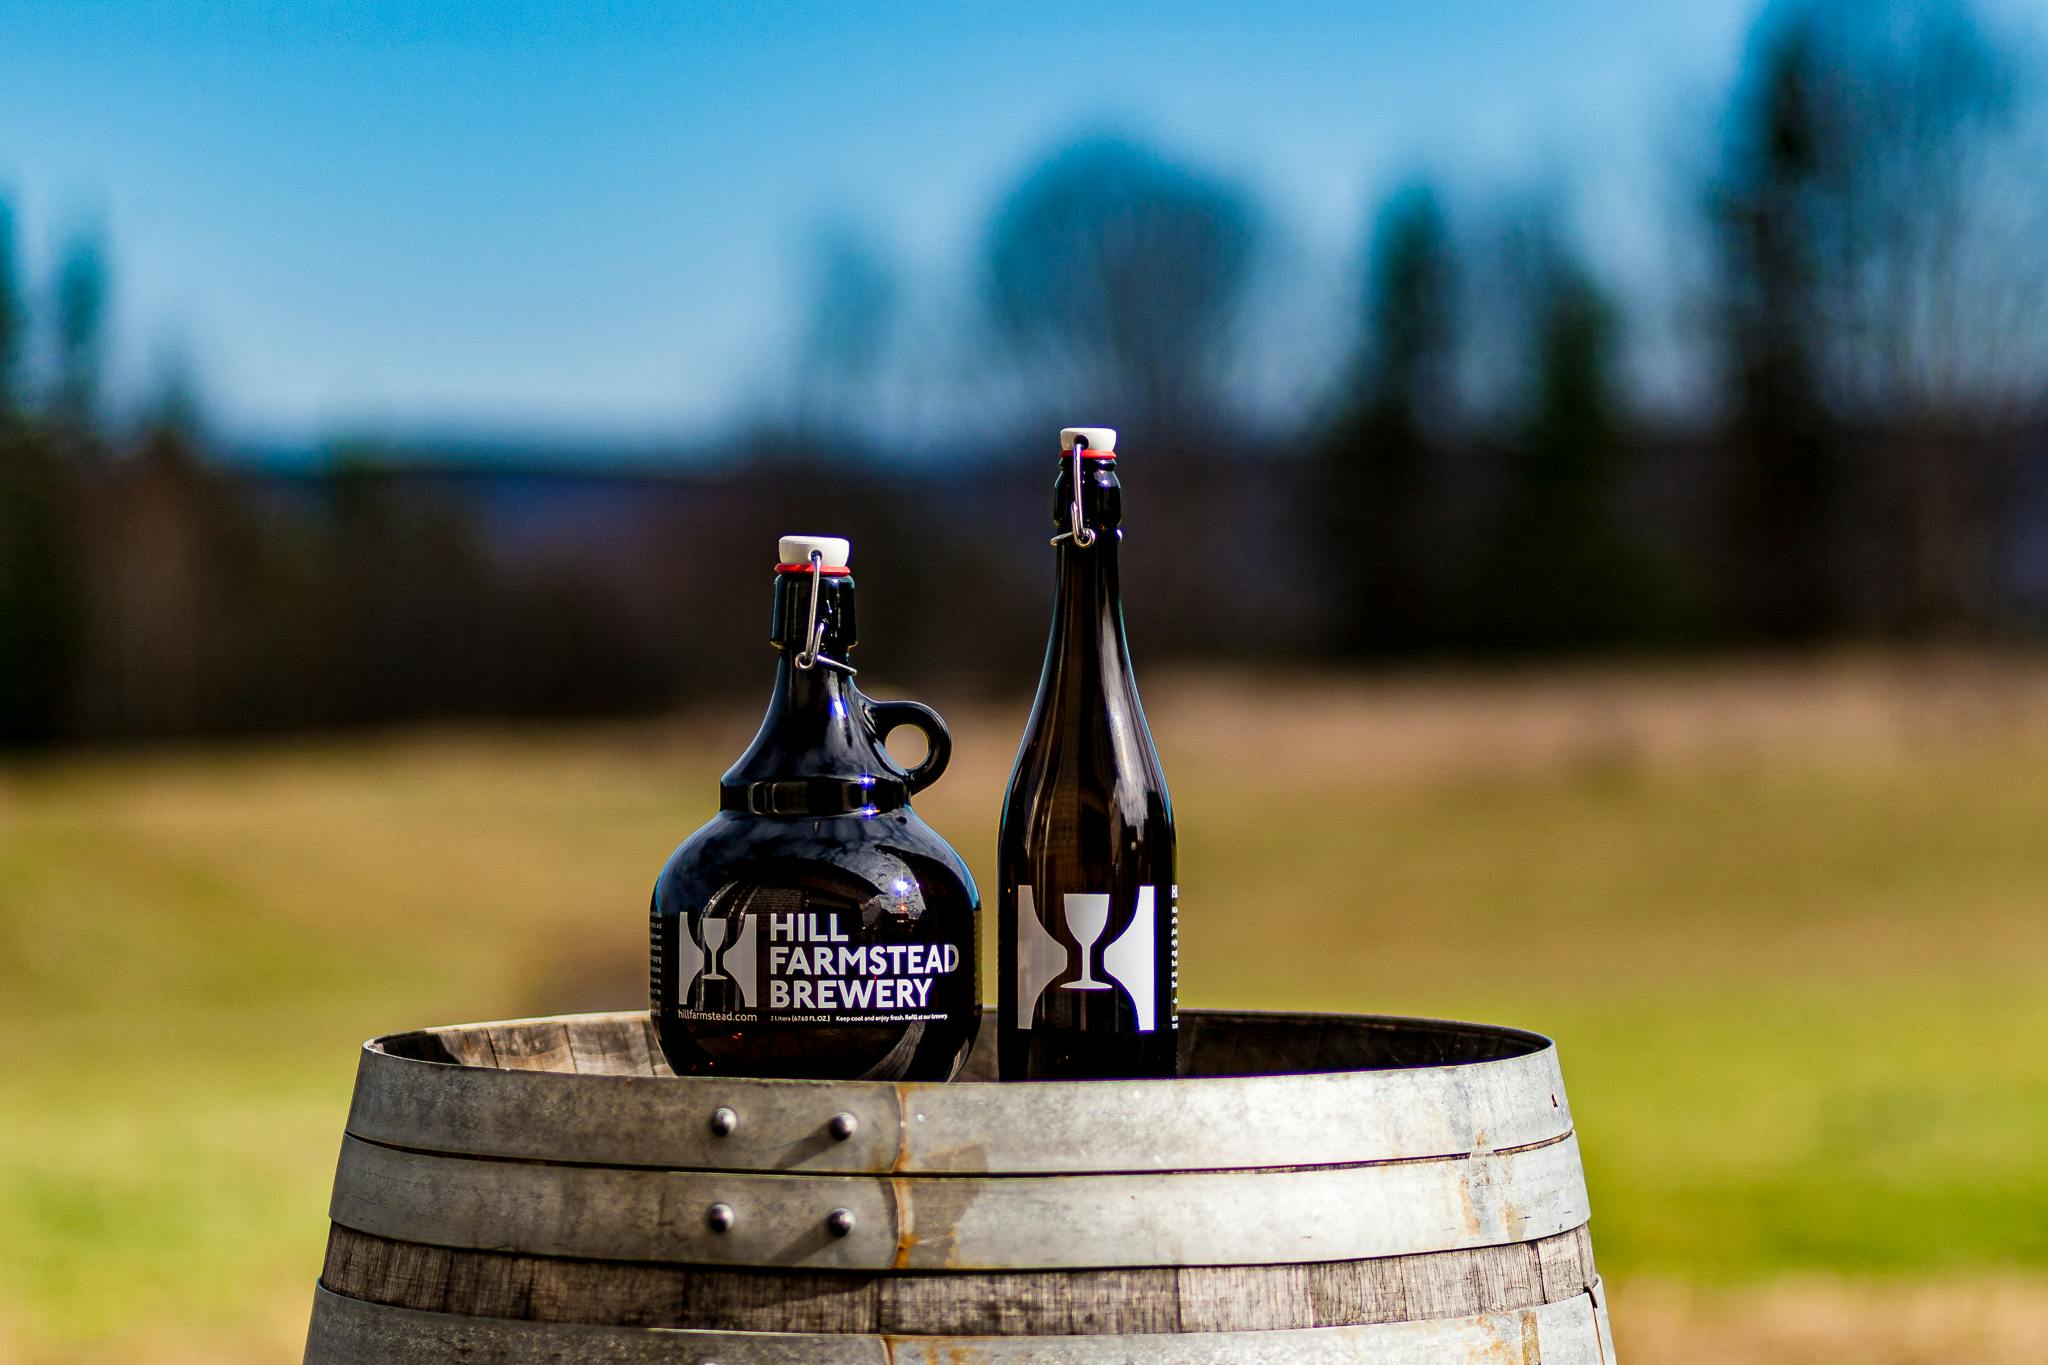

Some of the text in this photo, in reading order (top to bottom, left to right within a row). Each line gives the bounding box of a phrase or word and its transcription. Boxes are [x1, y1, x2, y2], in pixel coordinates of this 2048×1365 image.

[770, 913, 849, 942] HILL
[770, 944, 960, 976] FARMSTEAD
[770, 978, 933, 1009] BREWERY
[678, 1009, 757, 1022] hillfarmstead.com
[835, 1015, 850, 1023] Keep
